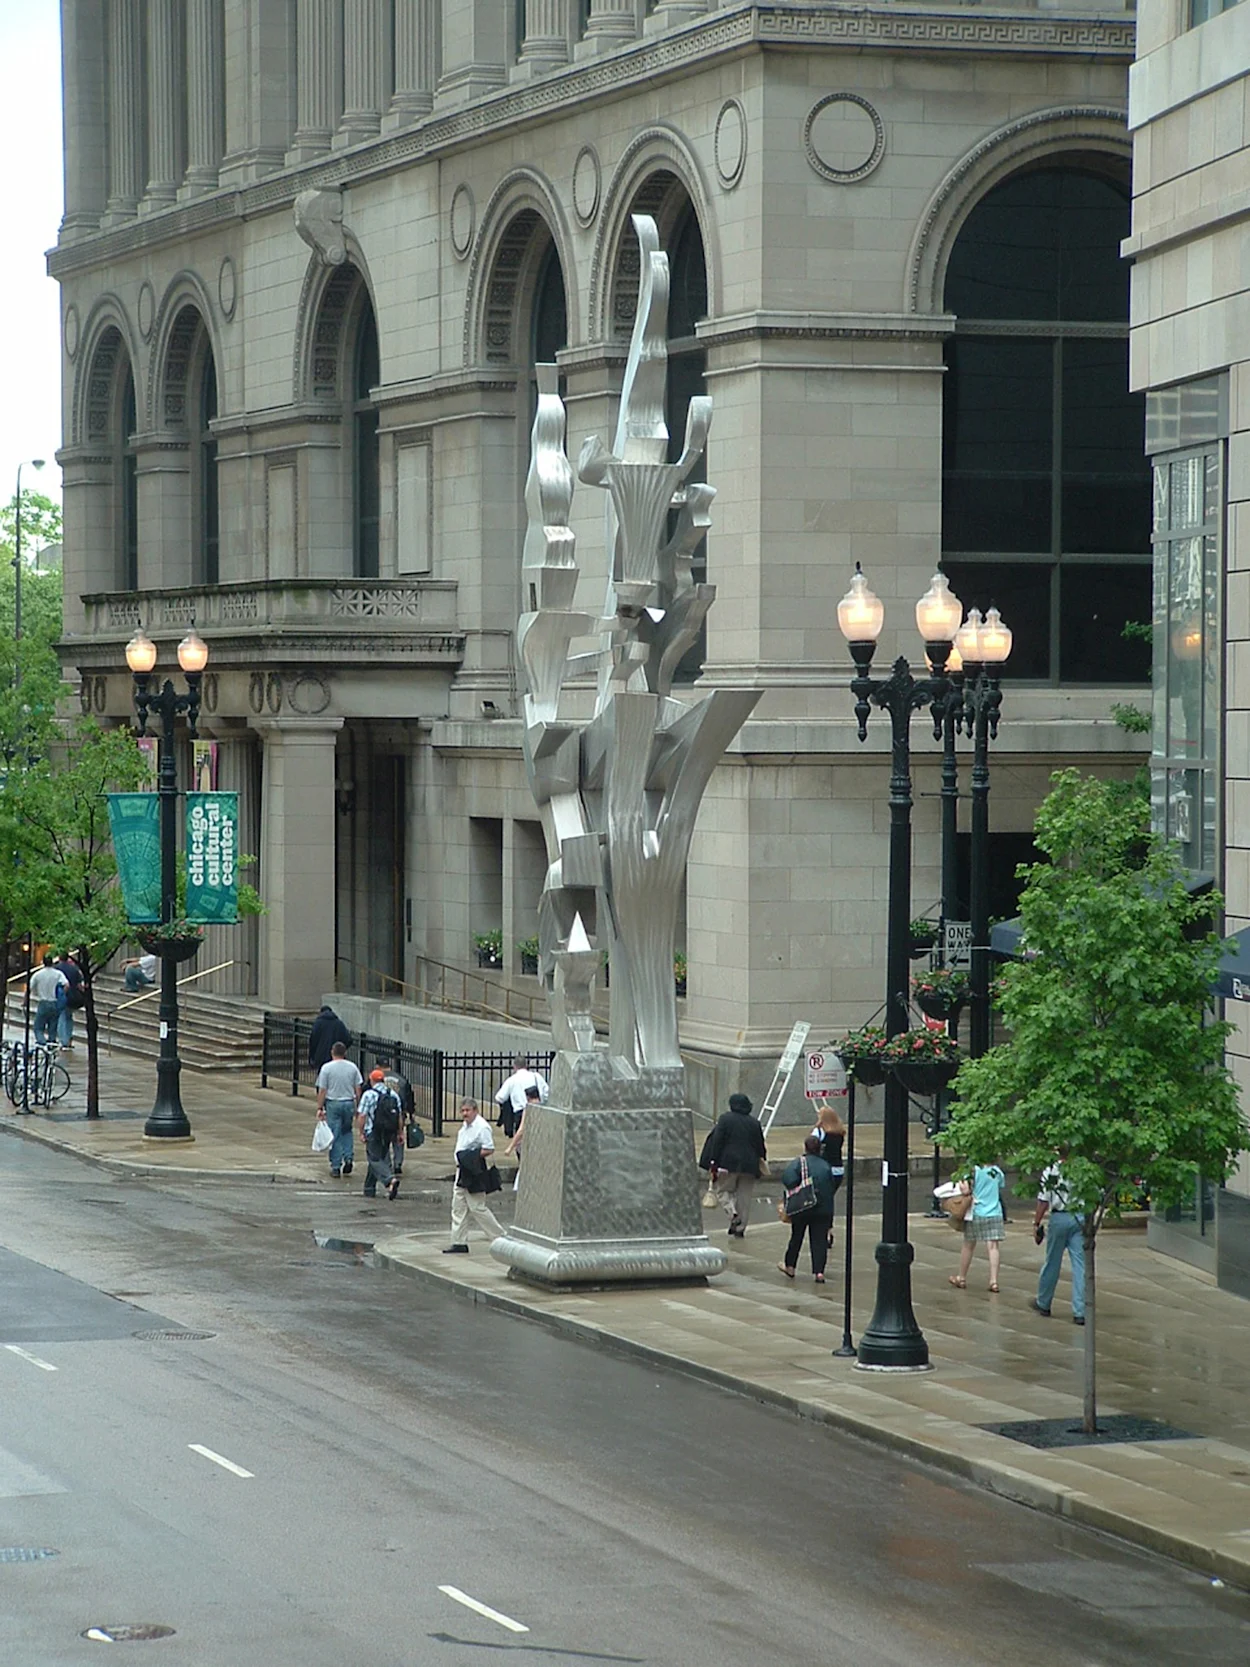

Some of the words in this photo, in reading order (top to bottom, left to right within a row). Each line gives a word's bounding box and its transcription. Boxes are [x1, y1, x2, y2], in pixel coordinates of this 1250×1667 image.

[189, 806, 208, 886] chicago
[205, 803, 220, 886] cultural
[220, 815, 233, 886] center
[948, 927, 971, 939] ONE
[948, 940, 970, 952] WAY
